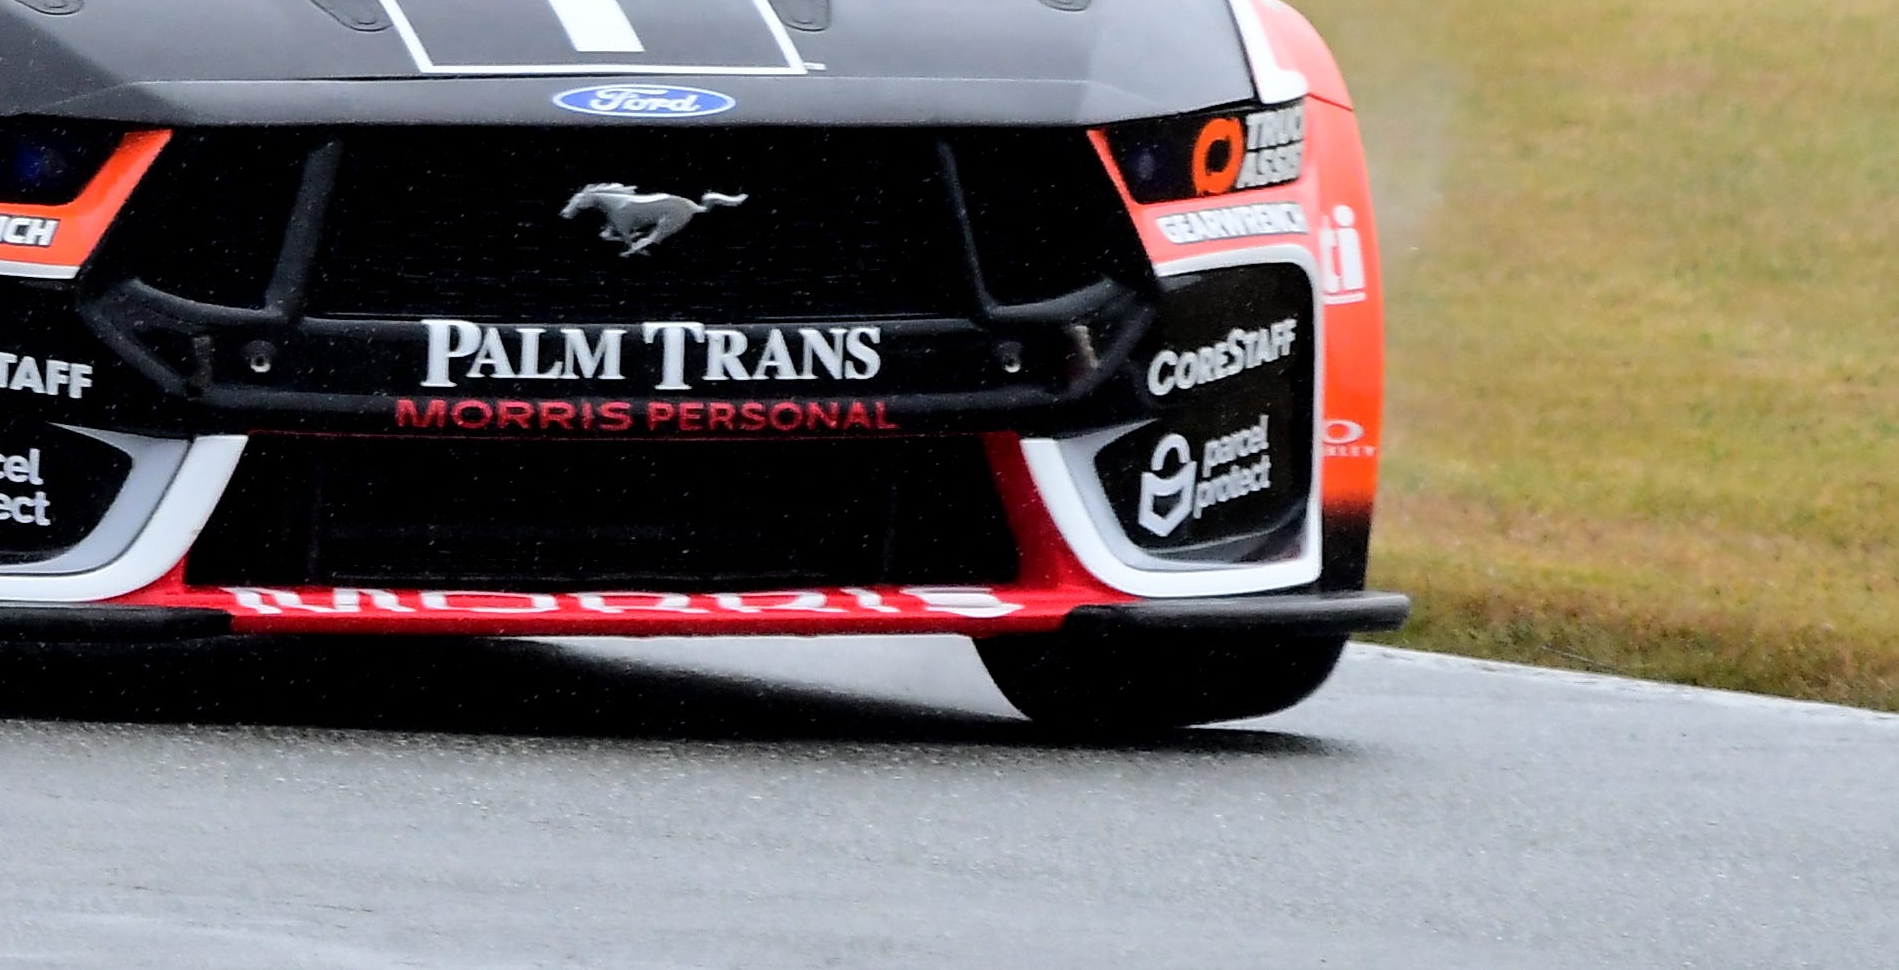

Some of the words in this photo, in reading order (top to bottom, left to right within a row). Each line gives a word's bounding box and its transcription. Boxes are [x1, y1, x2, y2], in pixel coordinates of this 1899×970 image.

[590, 88, 700, 112] Ford
[421, 319, 627, 388] PALM
[642, 321, 881, 390] TRANS
[395, 398, 634, 430] MORRIS
[646, 400, 902, 431] PERSONAL
[1203, 414, 1269, 478] parcel
[1193, 454, 1271, 520] protect
